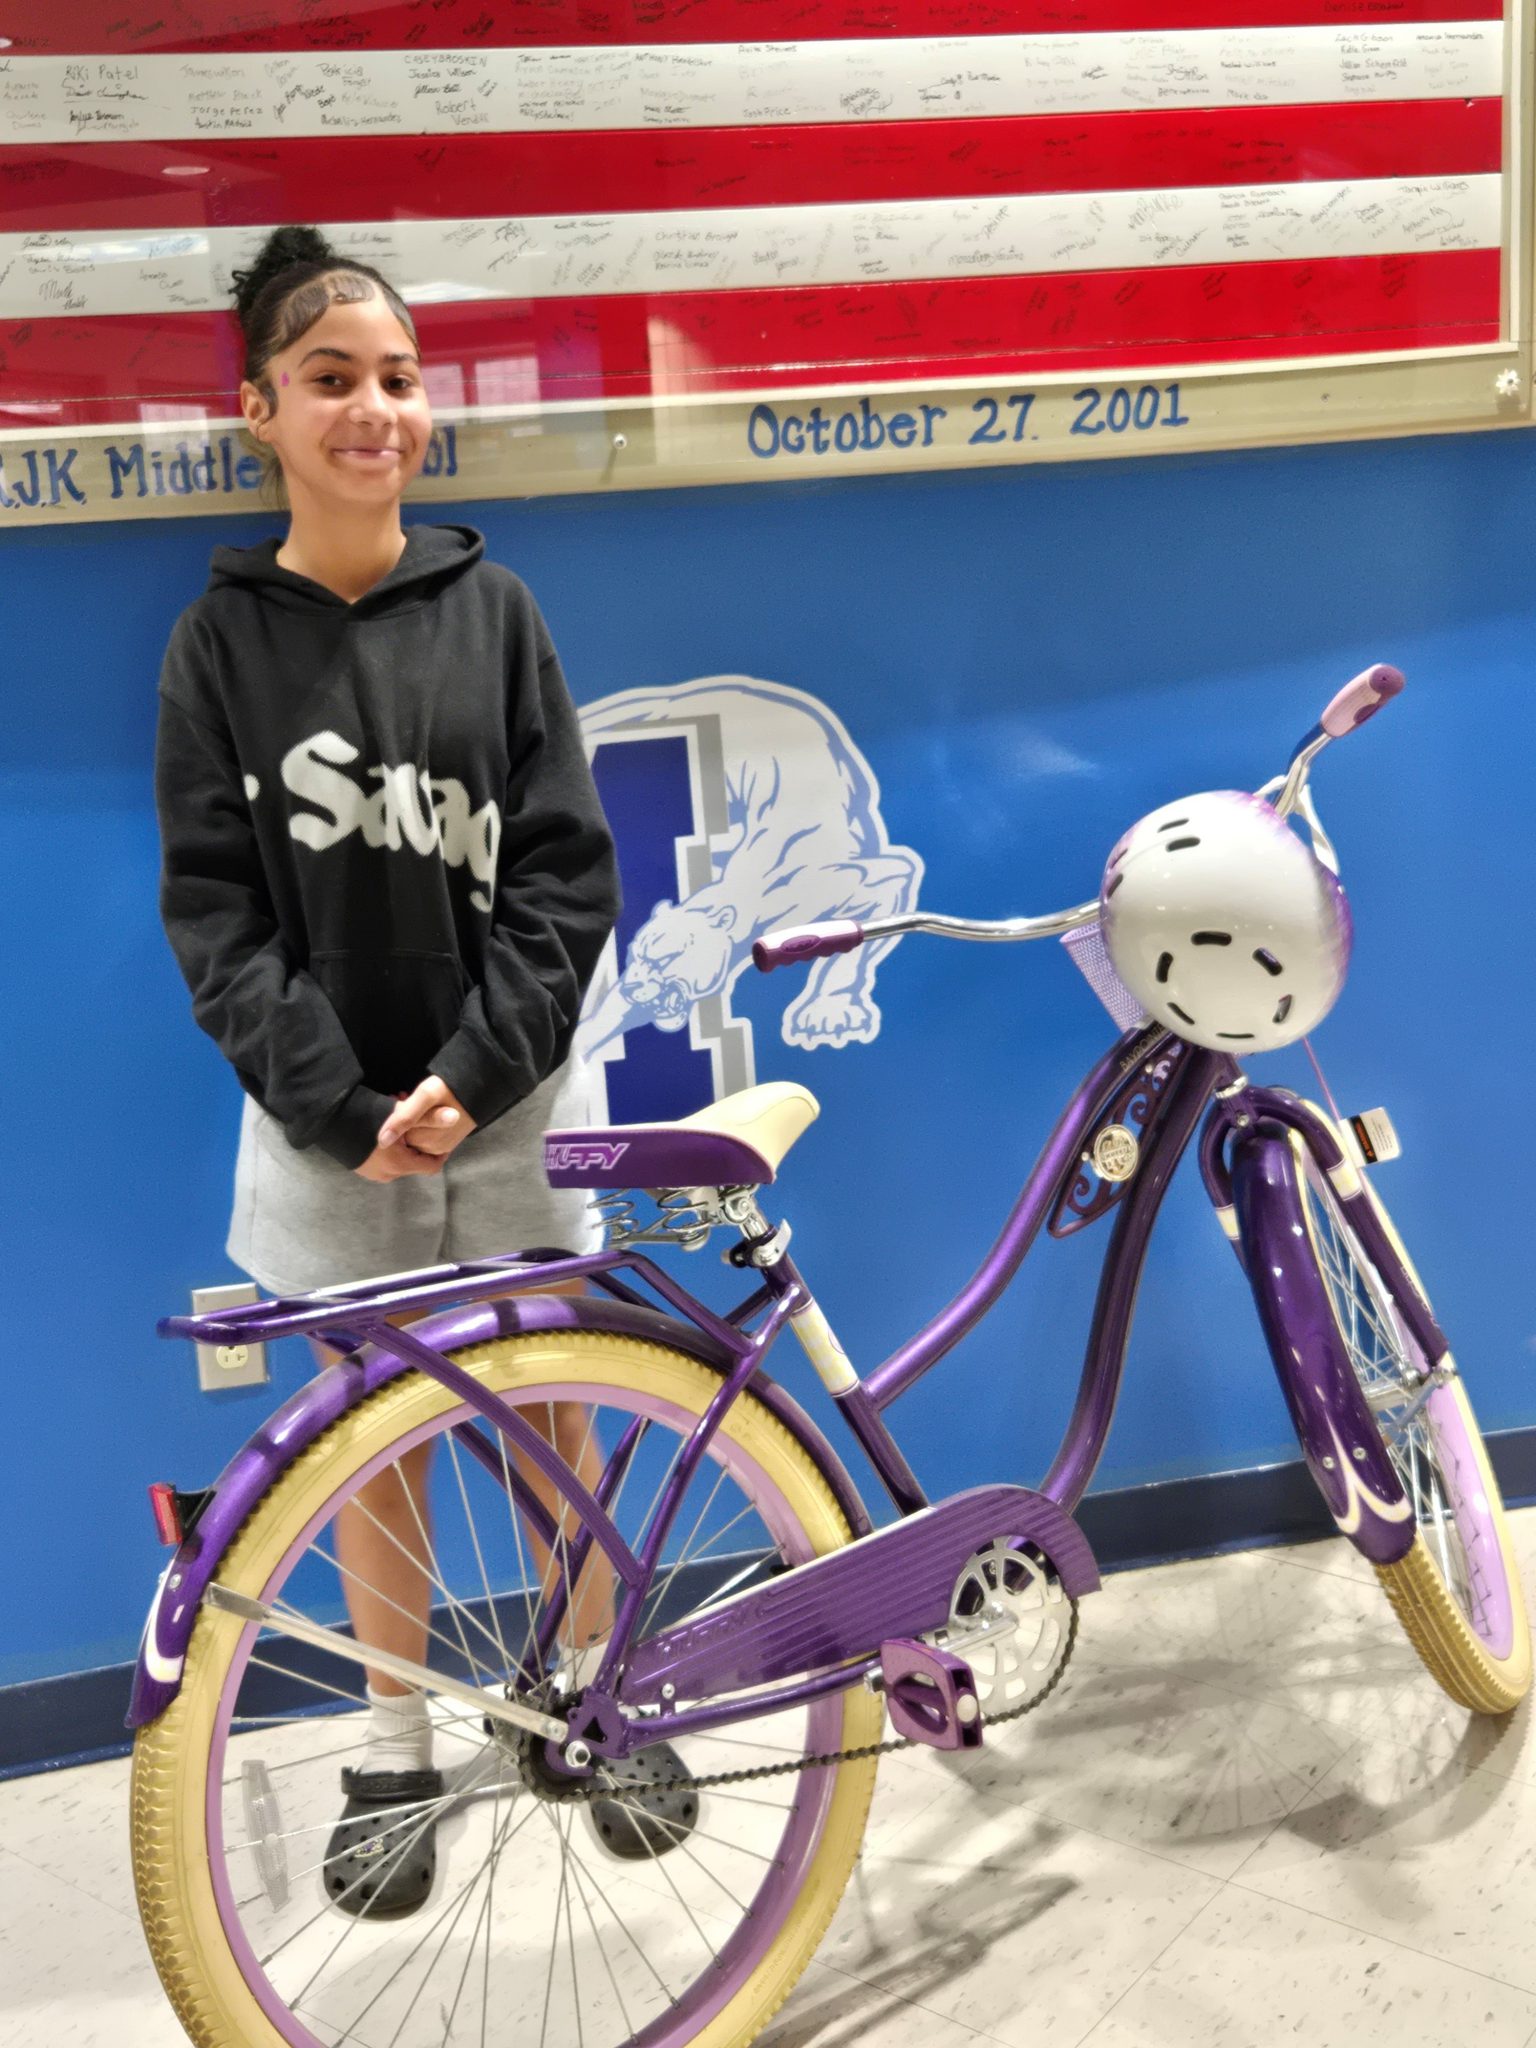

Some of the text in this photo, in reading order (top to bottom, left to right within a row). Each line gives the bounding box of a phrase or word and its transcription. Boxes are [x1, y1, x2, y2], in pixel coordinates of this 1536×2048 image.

[98, 63, 140, 81] Patel
[747, 397, 947, 458] October
[1069, 383, 1189, 435] 2001
[103, 438, 263, 499] Middle
